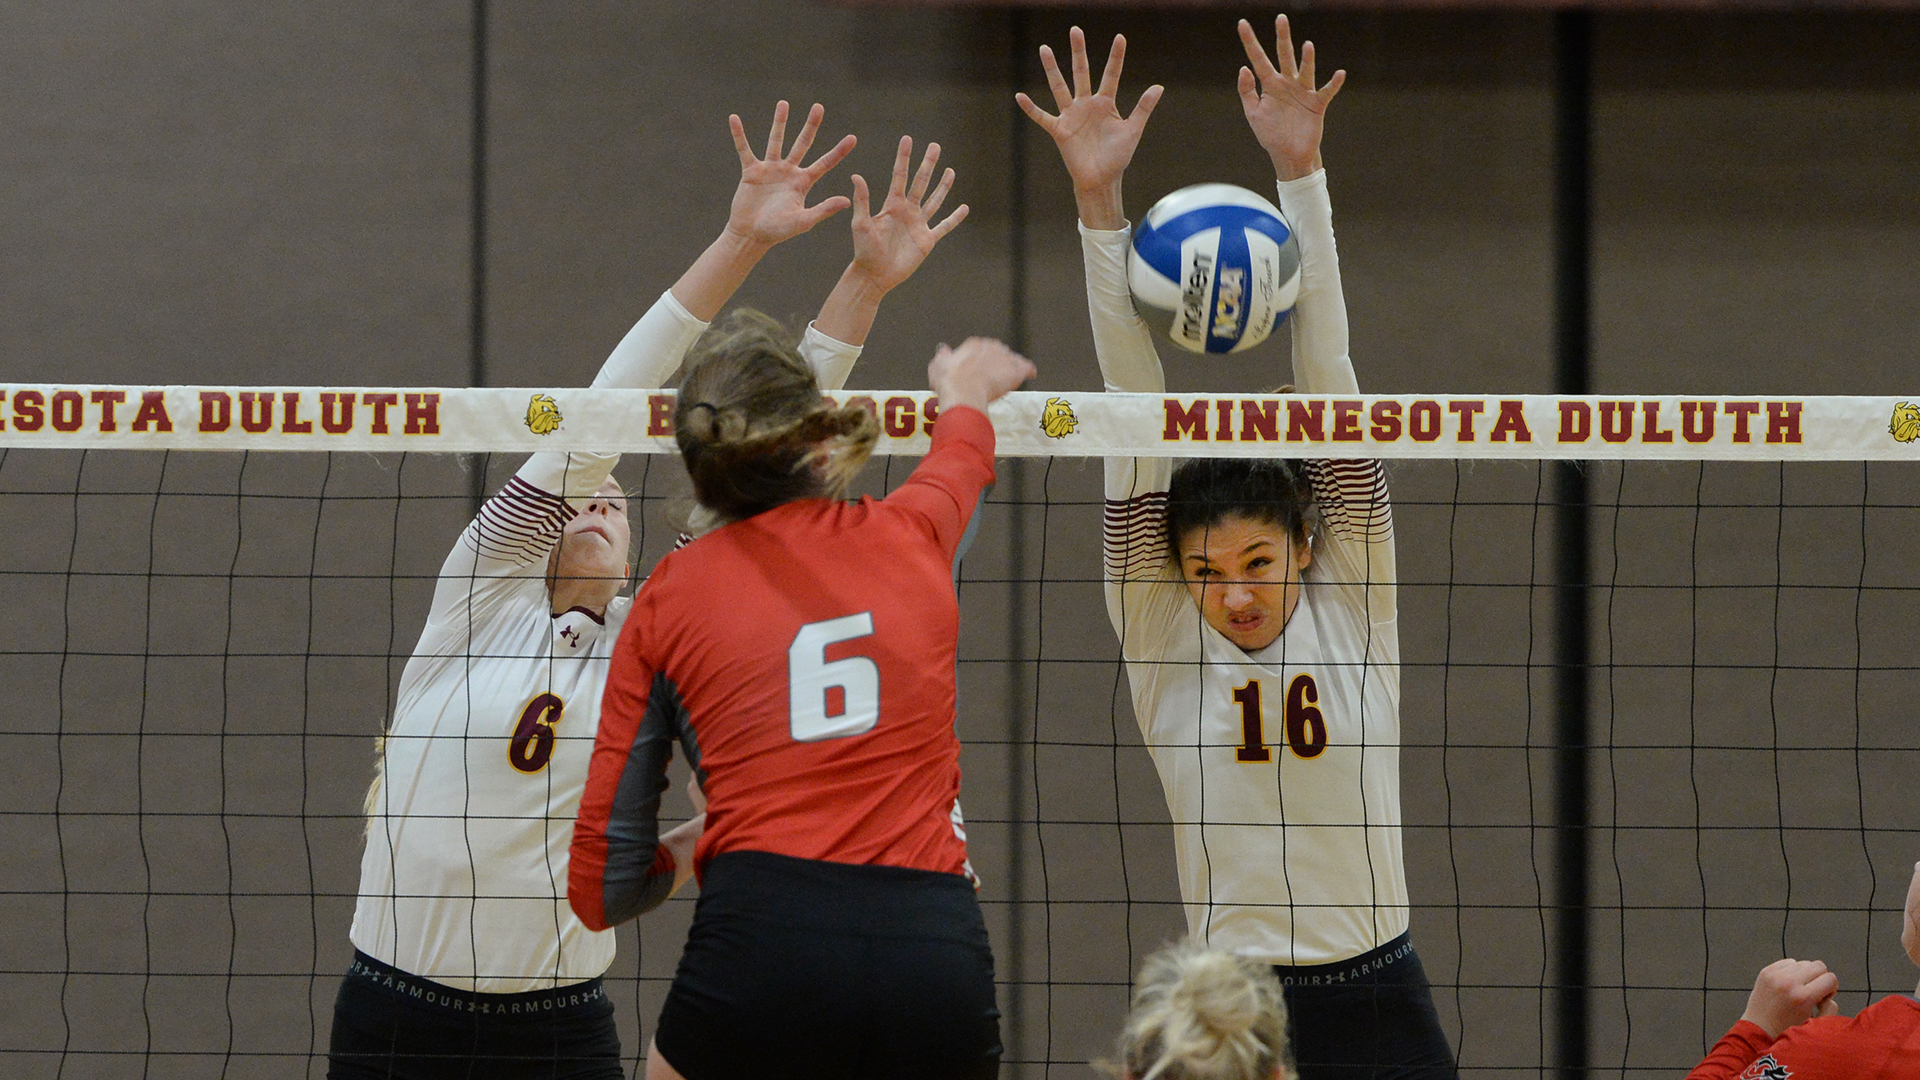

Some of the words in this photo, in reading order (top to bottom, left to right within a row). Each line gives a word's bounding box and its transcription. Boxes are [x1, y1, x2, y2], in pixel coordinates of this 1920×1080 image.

[1181, 250, 1212, 342] molten
[1212, 264, 1243, 340] NCAA
[198, 390, 442, 436] DULUTH
[1161, 399, 1533, 444] MINNESOTA
[1556, 400, 1804, 445] DULUTH
[787, 611, 881, 743] 6
[507, 690, 565, 775] 6
[1232, 672, 1329, 764] 16
[382, 975, 463, 1011] ARMOUR
[496, 994, 580, 1015] ARMOUR
[1350, 943, 1410, 980] ARMOUR
